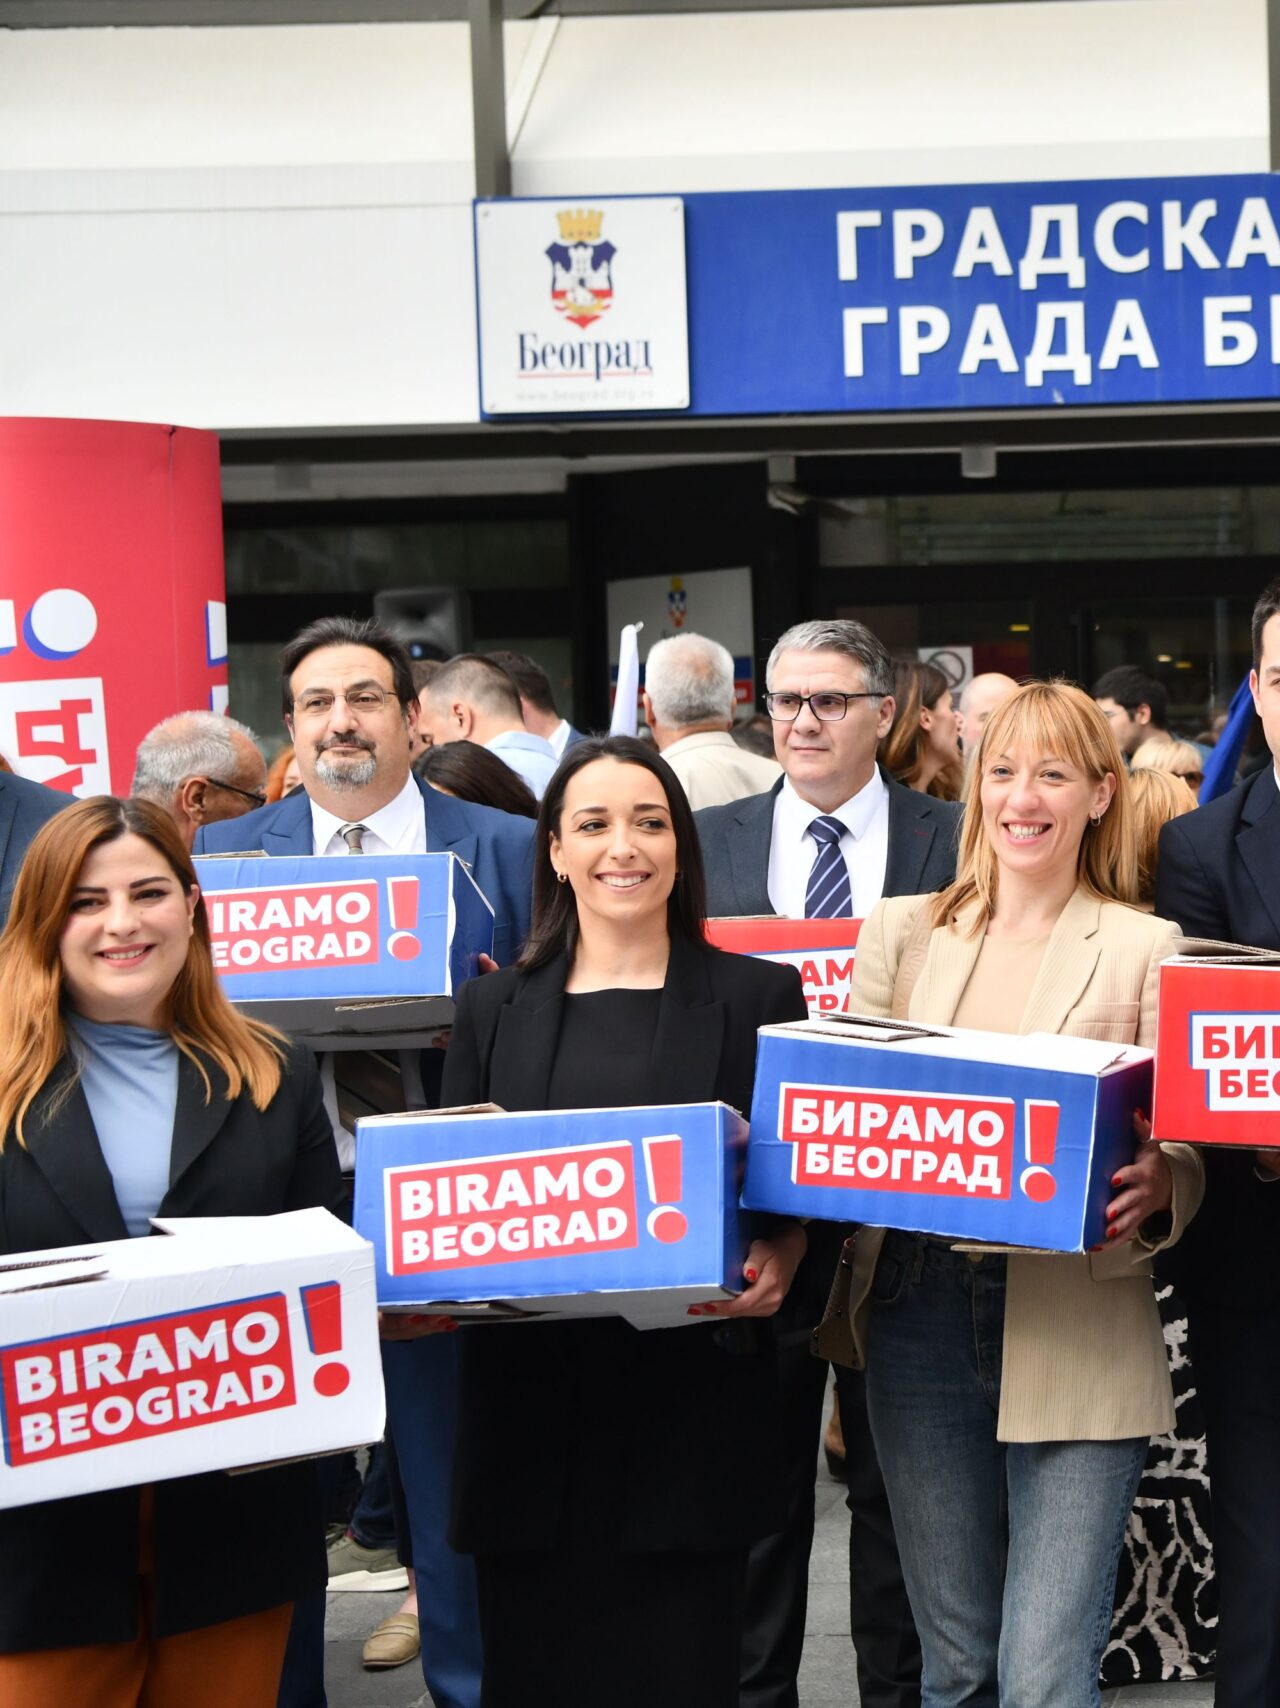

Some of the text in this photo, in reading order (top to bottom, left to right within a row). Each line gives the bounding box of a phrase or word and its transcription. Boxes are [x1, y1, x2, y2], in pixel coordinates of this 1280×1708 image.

[518, 332, 653, 381] Београд
[842, 299, 1159, 386] ГРАДА
[212, 892, 371, 933] IRAMO
[211, 931, 371, 967] EOGRAD
[791, 1097, 1005, 1147] БИРАМО
[400, 1157, 625, 1221] BIRAMO
[804, 1141, 1003, 1195] БЕОГРАД
[402, 1206, 628, 1264] BEOGRAD
[14, 1311, 281, 1405] BIRAMO
[20, 1364, 286, 1454] BEOGRAD
